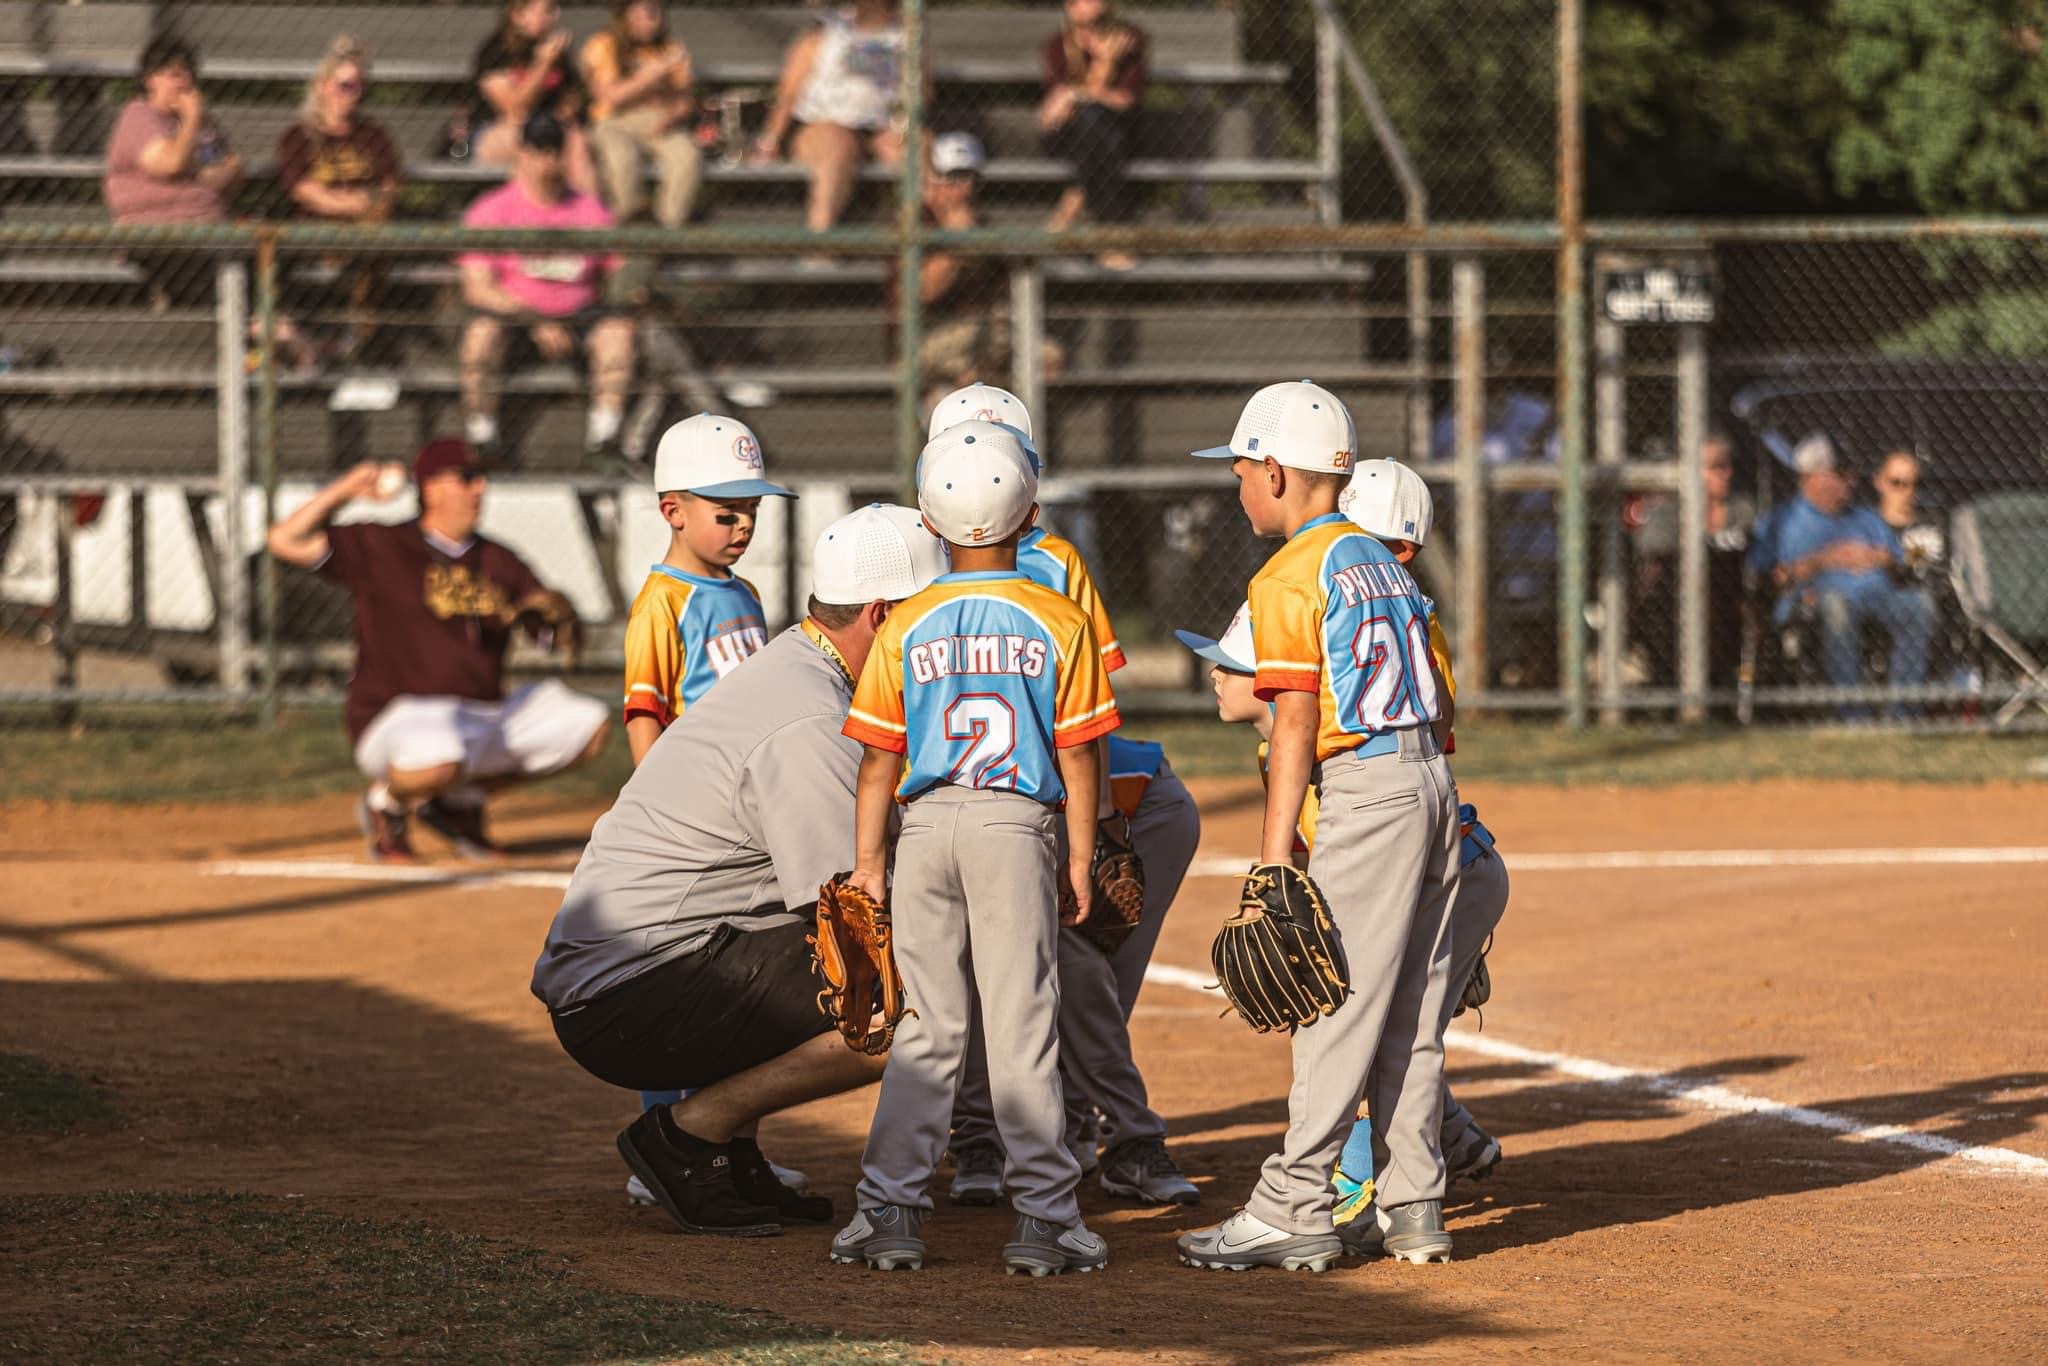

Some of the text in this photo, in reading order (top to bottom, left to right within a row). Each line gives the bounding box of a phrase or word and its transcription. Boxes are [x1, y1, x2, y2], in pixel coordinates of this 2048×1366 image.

[1333, 451, 1351, 468] 20
[973, 528, 984, 541] 2
[909, 634, 1047, 686] GRIMES
[944, 692, 1018, 791] 2
